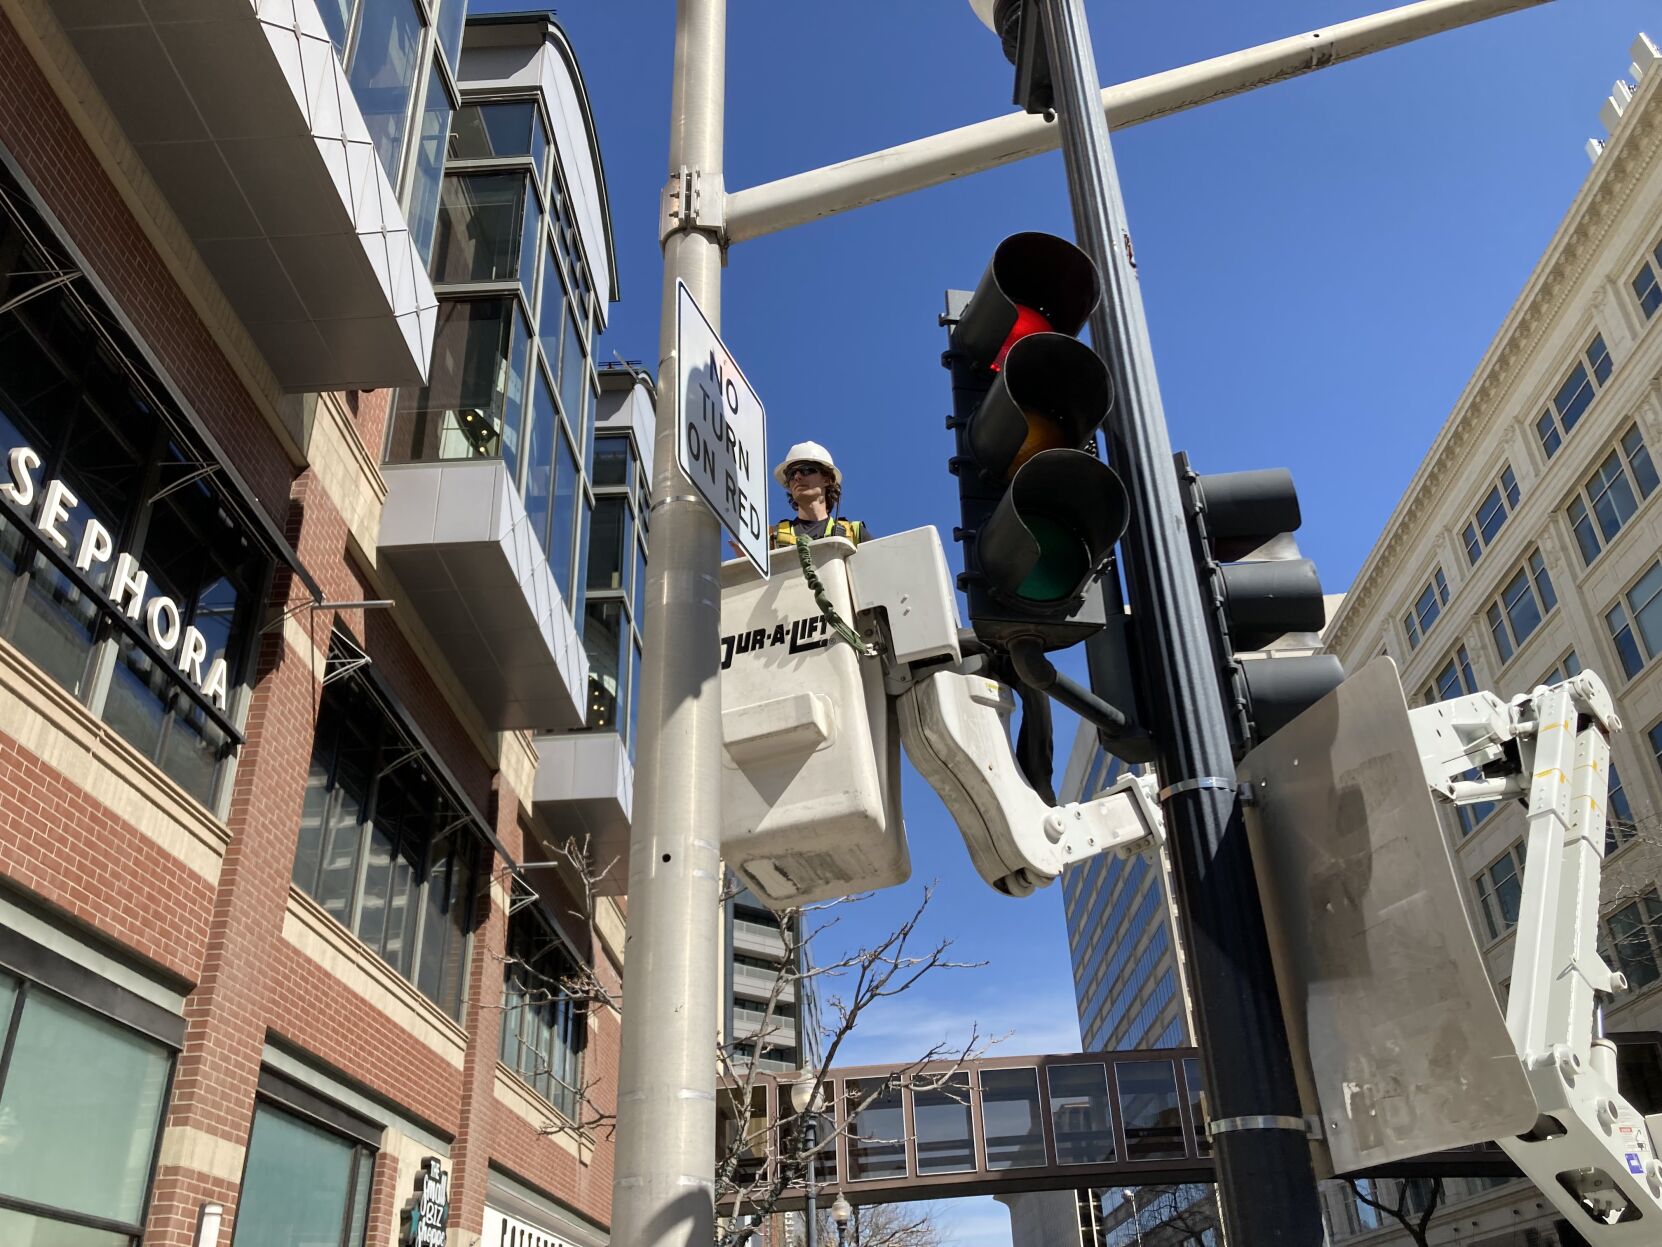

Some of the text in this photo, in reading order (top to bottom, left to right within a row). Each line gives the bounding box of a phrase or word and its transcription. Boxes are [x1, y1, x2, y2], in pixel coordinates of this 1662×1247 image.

[709, 348, 739, 415] NO
[688, 421, 761, 541] ON RED
[699, 382, 750, 482] TURN
[0, 447, 229, 711] SEPHORA
[426, 1202, 444, 1227] BIZ
